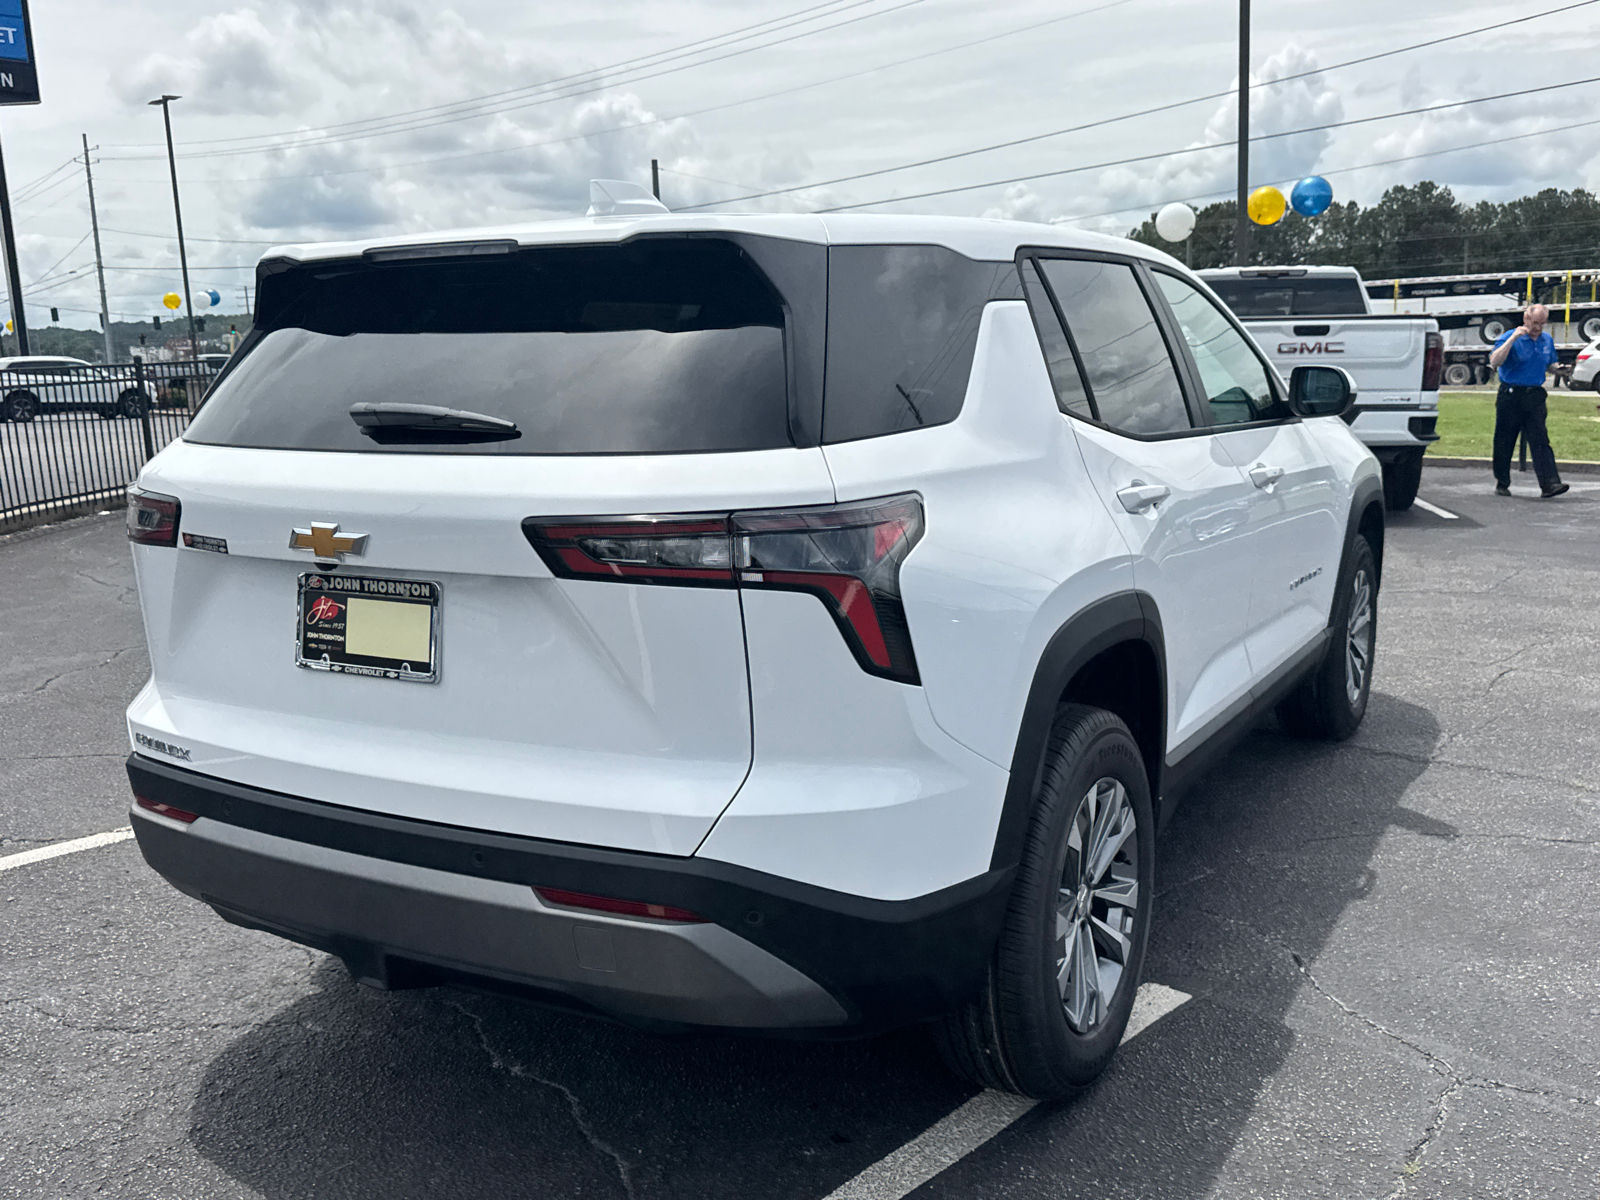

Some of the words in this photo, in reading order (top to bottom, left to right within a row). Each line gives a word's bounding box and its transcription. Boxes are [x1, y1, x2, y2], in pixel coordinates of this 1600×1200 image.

[1277, 342, 1344, 354] GMC
[329, 577, 360, 590] JOHN
[362, 580, 430, 597] THORNTON
[307, 631, 319, 639] JOHN
[319, 633, 345, 641] THORNTON
[344, 666, 384, 677] CHEVROLET
